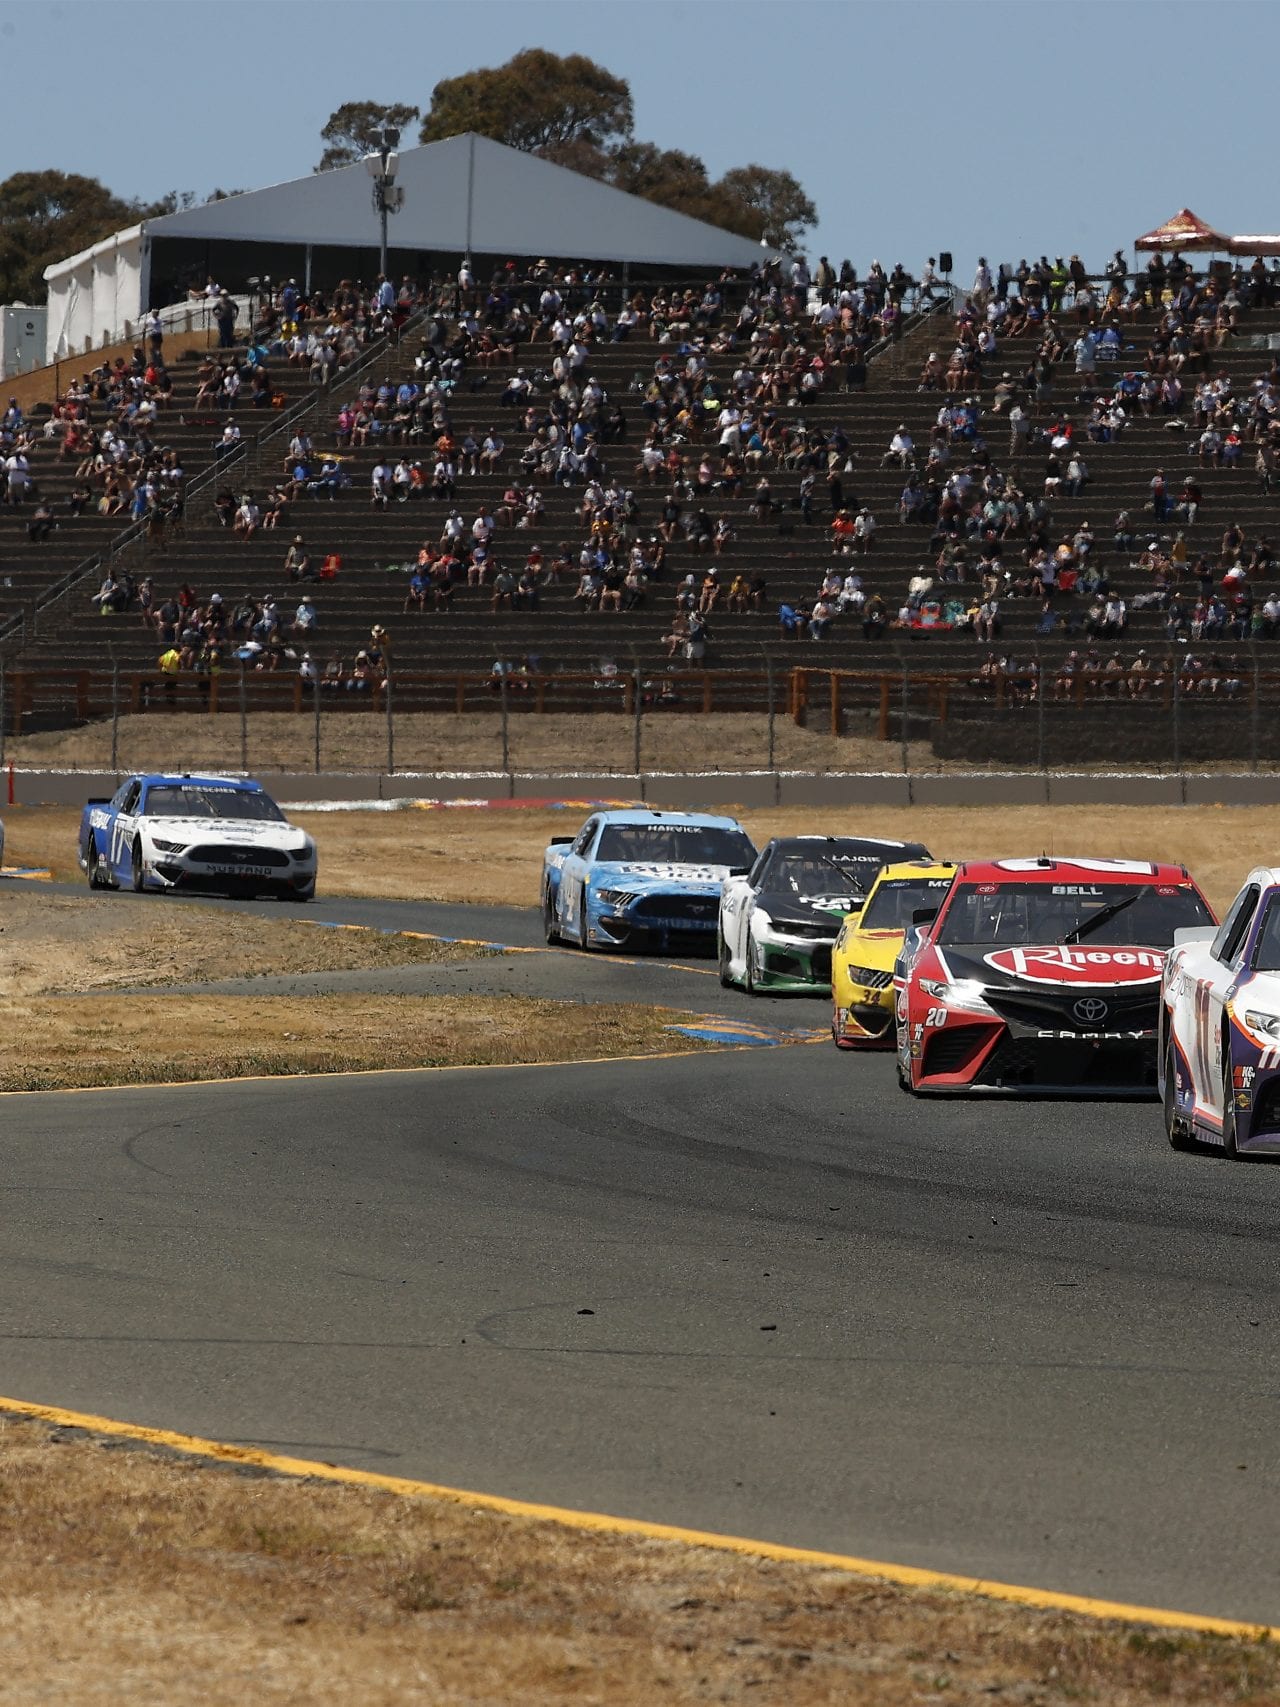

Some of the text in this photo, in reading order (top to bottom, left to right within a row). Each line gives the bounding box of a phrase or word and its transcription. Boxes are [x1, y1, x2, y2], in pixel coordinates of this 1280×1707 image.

[647, 825, 703, 833] HARVICK
[831, 854, 881, 863] LAJOIE
[206, 863, 273, 875] MUSTANG
[1051, 885, 1104, 896] BELL
[1011, 945, 1165, 973] Rheem
[862, 989, 881, 1006] 34
[925, 1007, 949, 1027] 20
[1037, 1030, 1144, 1040] CAMRY
